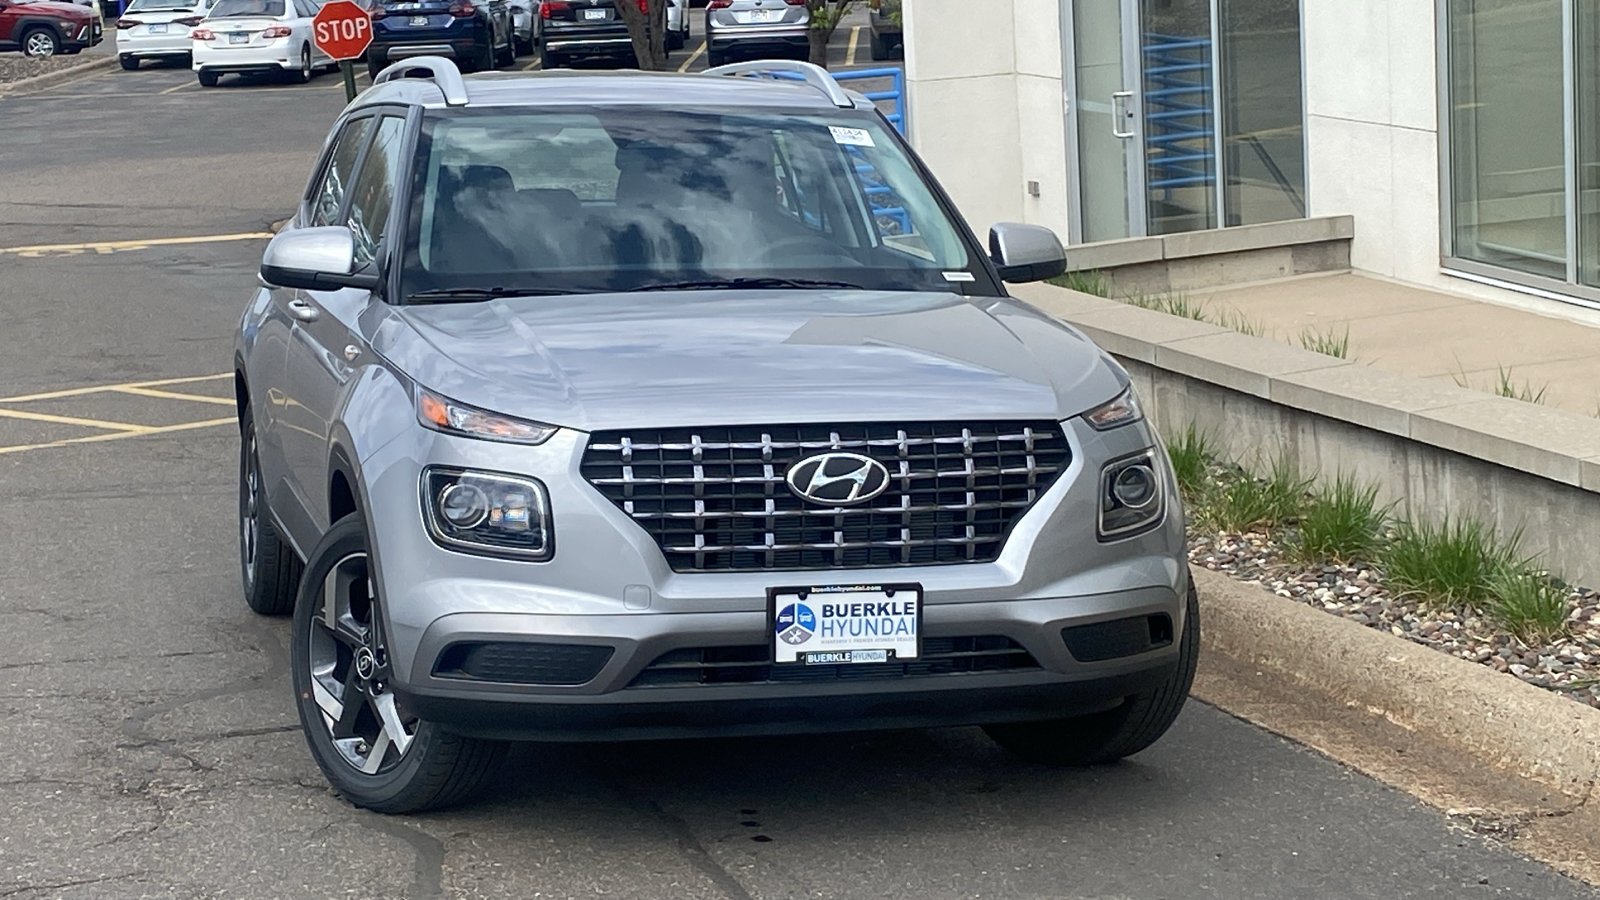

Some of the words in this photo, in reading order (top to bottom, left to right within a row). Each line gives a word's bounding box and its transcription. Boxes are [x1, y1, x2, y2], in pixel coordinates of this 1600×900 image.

[317, 17, 368, 43] STOP
[822, 602, 915, 617] BUERKLE
[821, 617, 915, 637] HYUNDAI
[807, 653, 851, 663] BUERKLE
[852, 651, 885, 661] HYUNDAI
